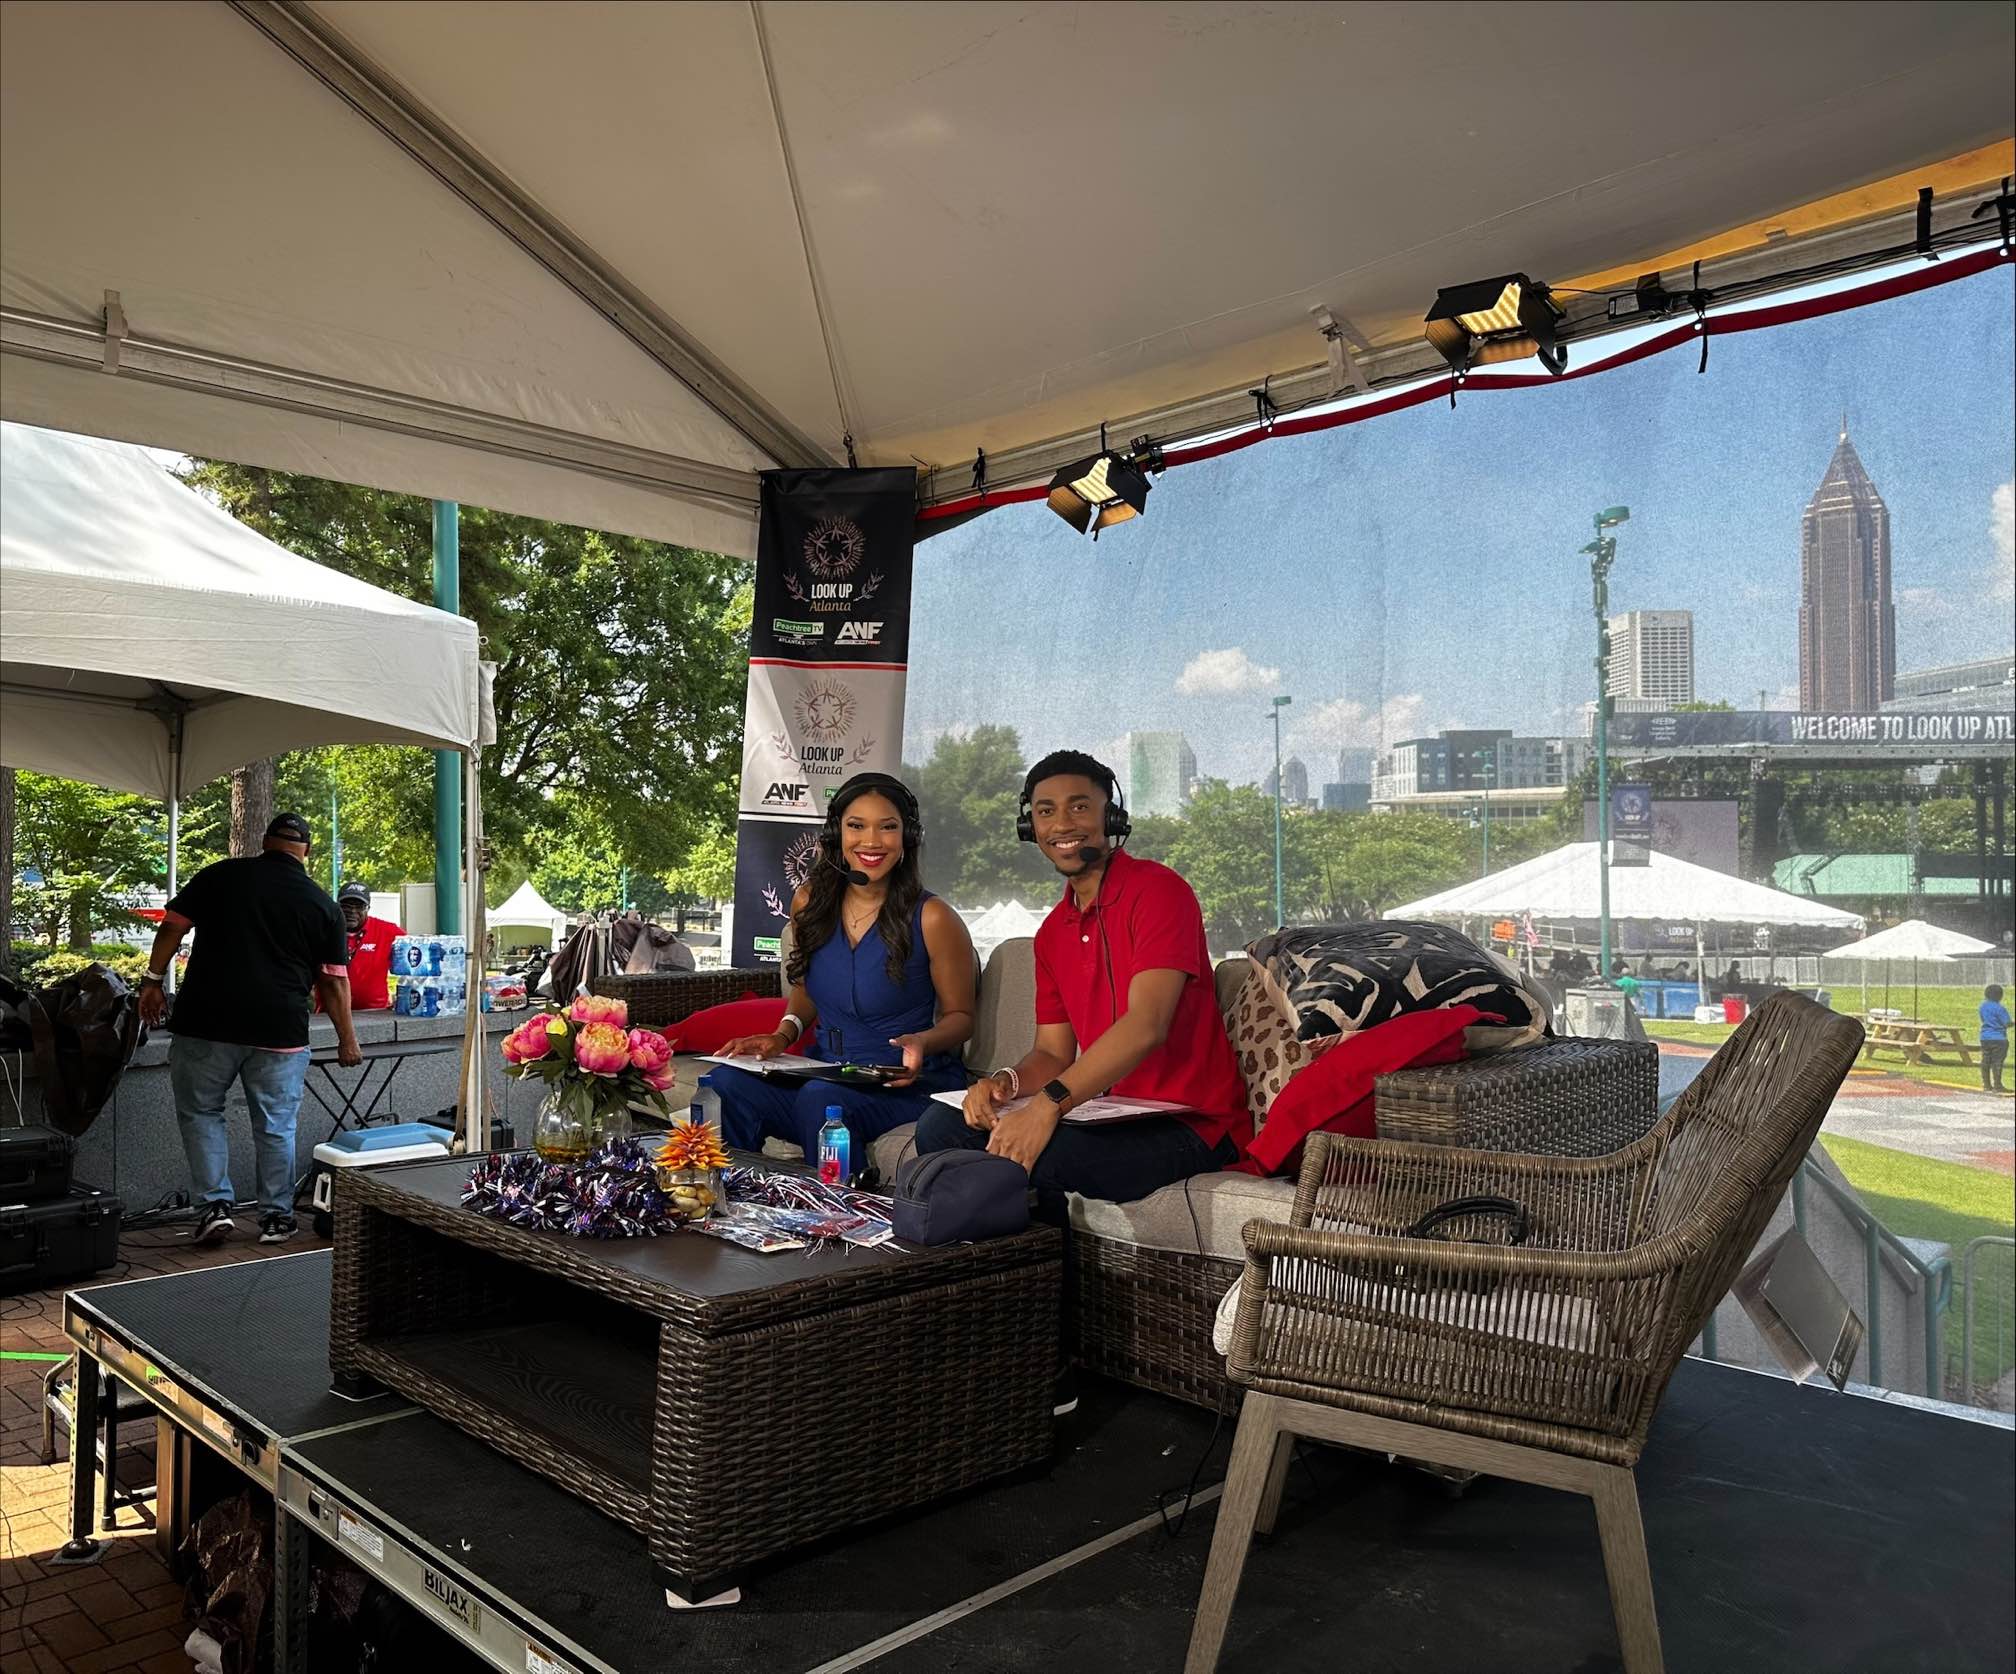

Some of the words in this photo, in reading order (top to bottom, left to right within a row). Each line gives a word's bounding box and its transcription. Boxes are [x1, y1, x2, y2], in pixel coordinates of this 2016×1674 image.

[811, 583, 837, 599] LOOK
[838, 583, 853, 599] UP
[809, 600, 851, 612] Atlanta
[776, 621, 812, 632] Peachtree
[837, 621, 884, 639] ANF
[1792, 716, 1877, 740] WELCOME
[1881, 716, 1903, 740] TO
[1908, 716, 1953, 740] LOOK
[1957, 716, 1981, 740] UP
[1984, 716, 2015, 740] ATL
[801, 746, 829, 762] LOOK
[831, 747, 844, 762] UP
[798, 762, 843, 775] Atlanta
[764, 783, 810, 801] ANF
[821, 1146, 838, 1161] FIJI
